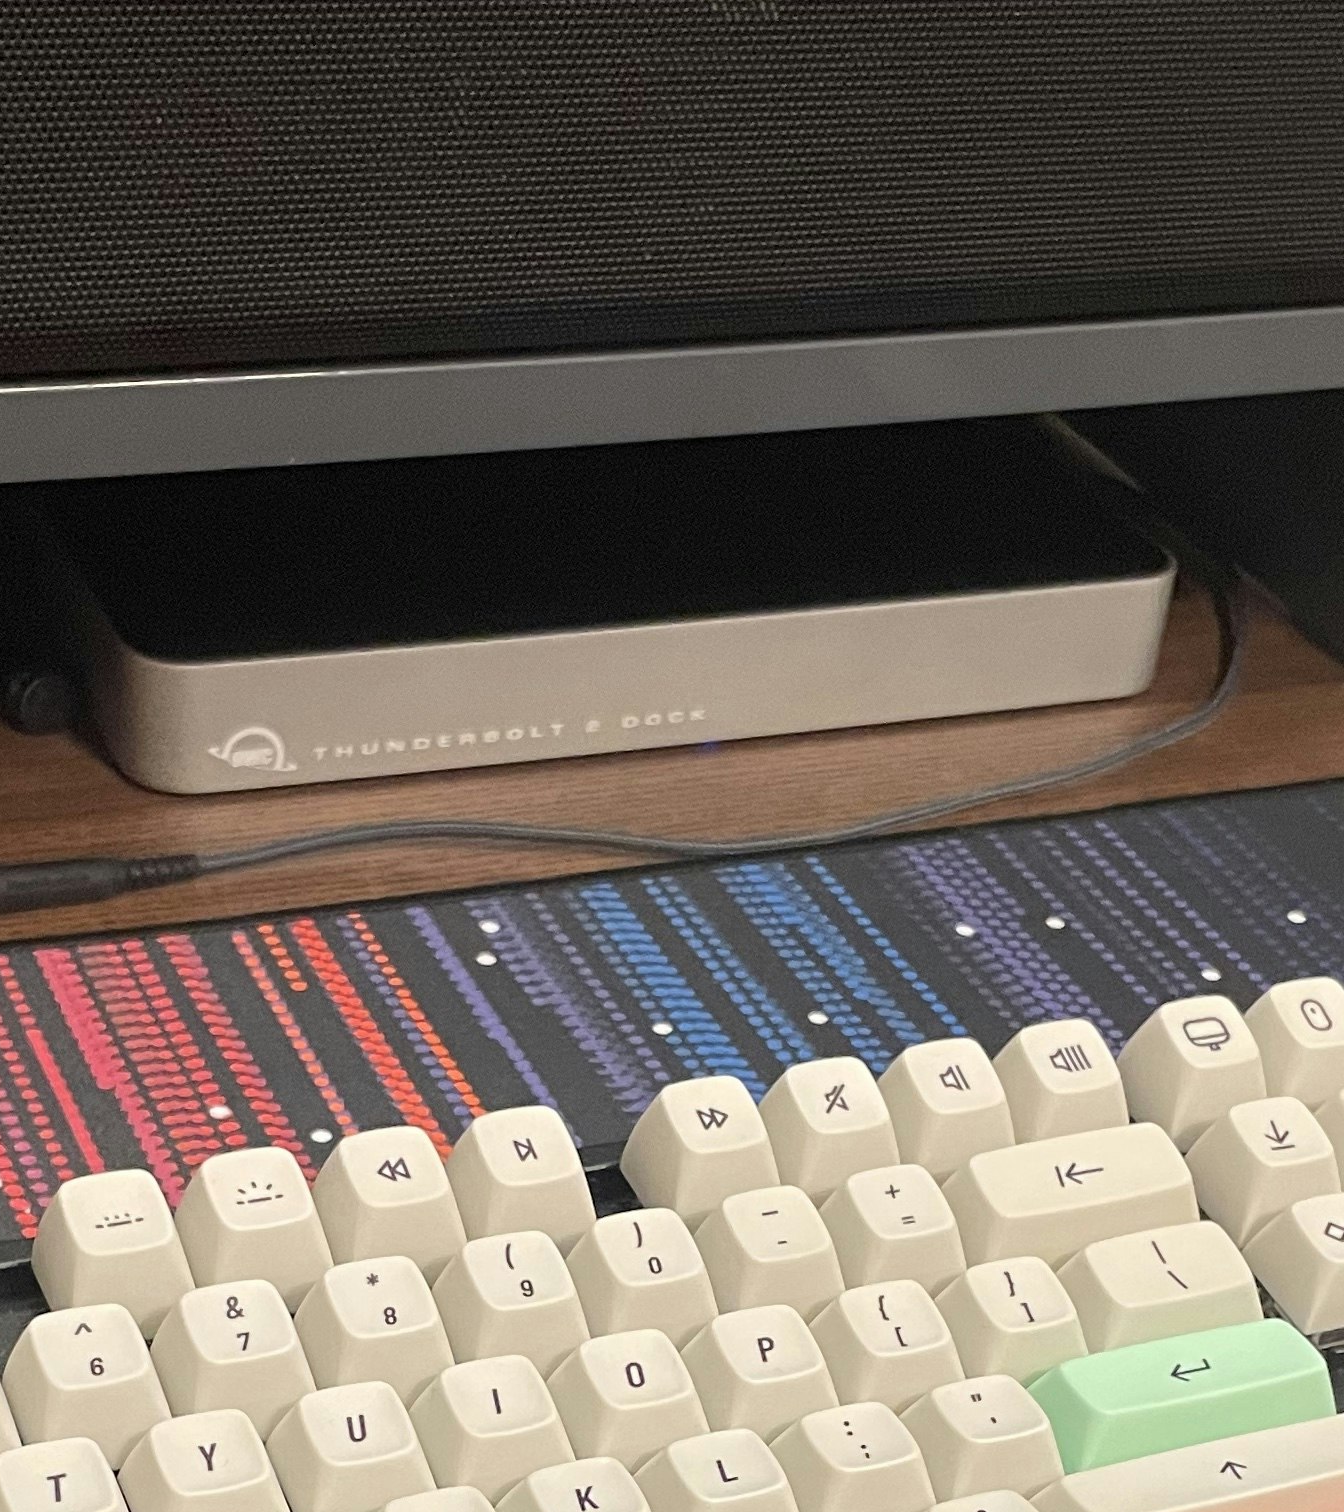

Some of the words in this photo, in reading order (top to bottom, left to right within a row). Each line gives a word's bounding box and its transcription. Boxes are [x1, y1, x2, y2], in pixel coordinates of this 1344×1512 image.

[312, 723, 565, 761] THUNDERBOLT
[620, 709, 706, 730] DOCK
[885, 1184, 900, 1199] +
[901, 1215, 916, 1225] =
[632, 1221, 643, 1248] )
[505, 1243, 515, 1270] (
[647, 1256, 663, 1275] 0
[519, 1279, 535, 1298] 9
[1003, 1271, 1016, 1298] }
[226, 1295, 245, 1320] &
[383, 1306, 398, 1326] 8
[878, 1294, 890, 1322] {
[1020, 1302, 1036, 1323] ]
[236, 1331, 250, 1352] 7
[757, 1336, 775, 1363] P
[894, 1326, 908, 1348] [
[89, 1357, 105, 1377] 6
[625, 1361, 646, 1388] O
[491, 1388, 502, 1415] I
[346, 1414, 367, 1443] U
[197, 1442, 217, 1472] Y
[715, 1459, 739, 1483] L
[46, 1473, 67, 1503] T
[575, 1485, 599, 1512] K
